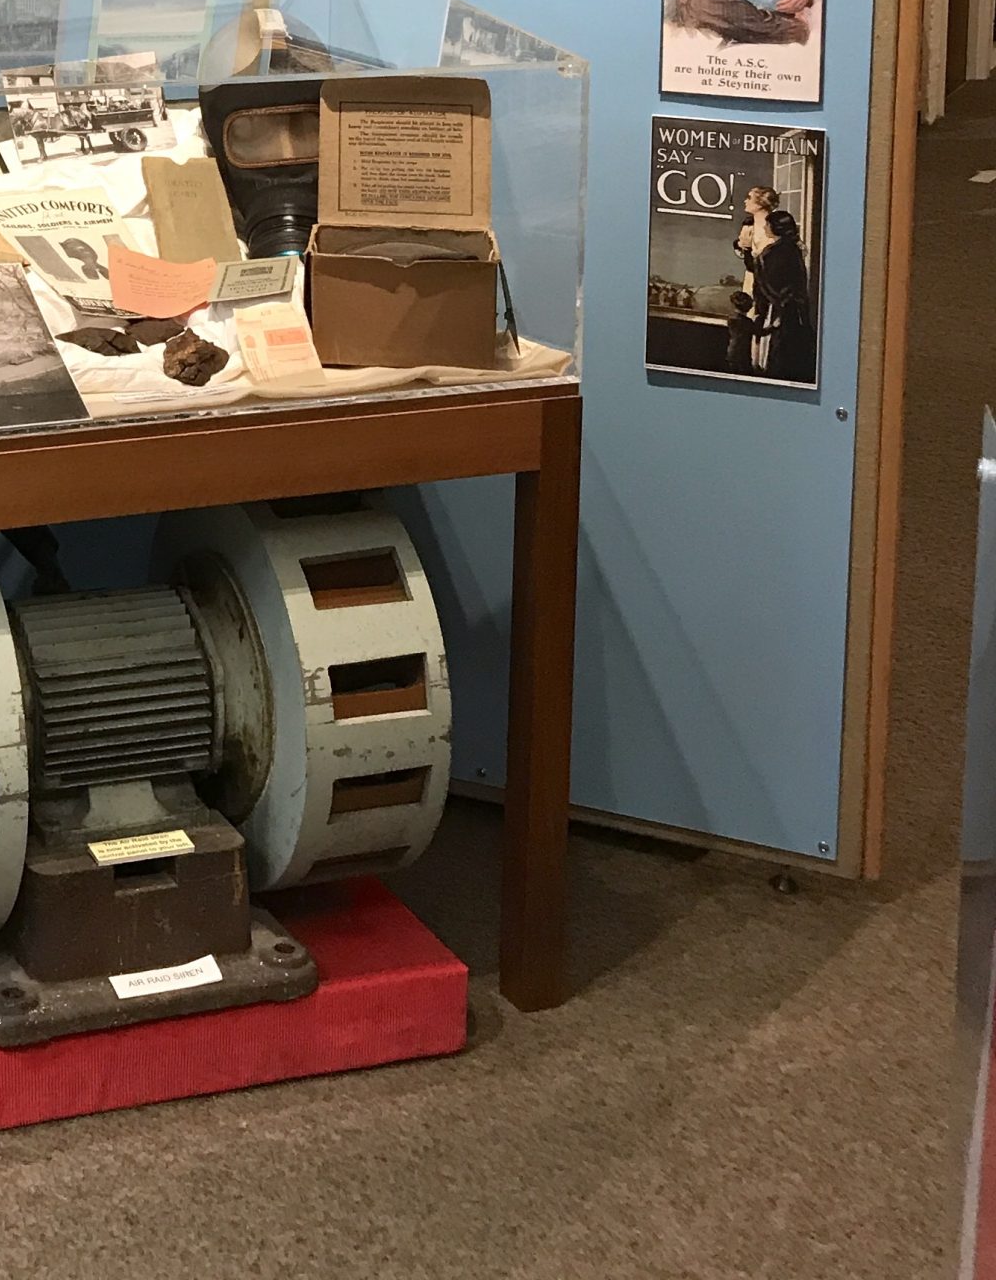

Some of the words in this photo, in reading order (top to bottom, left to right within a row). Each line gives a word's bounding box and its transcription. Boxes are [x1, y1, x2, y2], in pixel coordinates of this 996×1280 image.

[707, 56, 728, 66] The
[734, 58, 768, 68] A.S.C.
[674, 66, 692, 74] are
[698, 66, 739, 78] holding
[745, 69, 772, 80] their
[777, 73, 801, 82] own
[701, 78, 713, 86] at
[718, 78, 771, 91] Steyning.
[659, 127, 731, 149] WOMEN
[743, 134, 818, 155] BRITAIN
[40, 200, 113, 216] COMFORTS
[128, 979, 144, 987] AIR
[146, 974, 170, 984] RAID
[173, 967, 203, 980] SIREN
